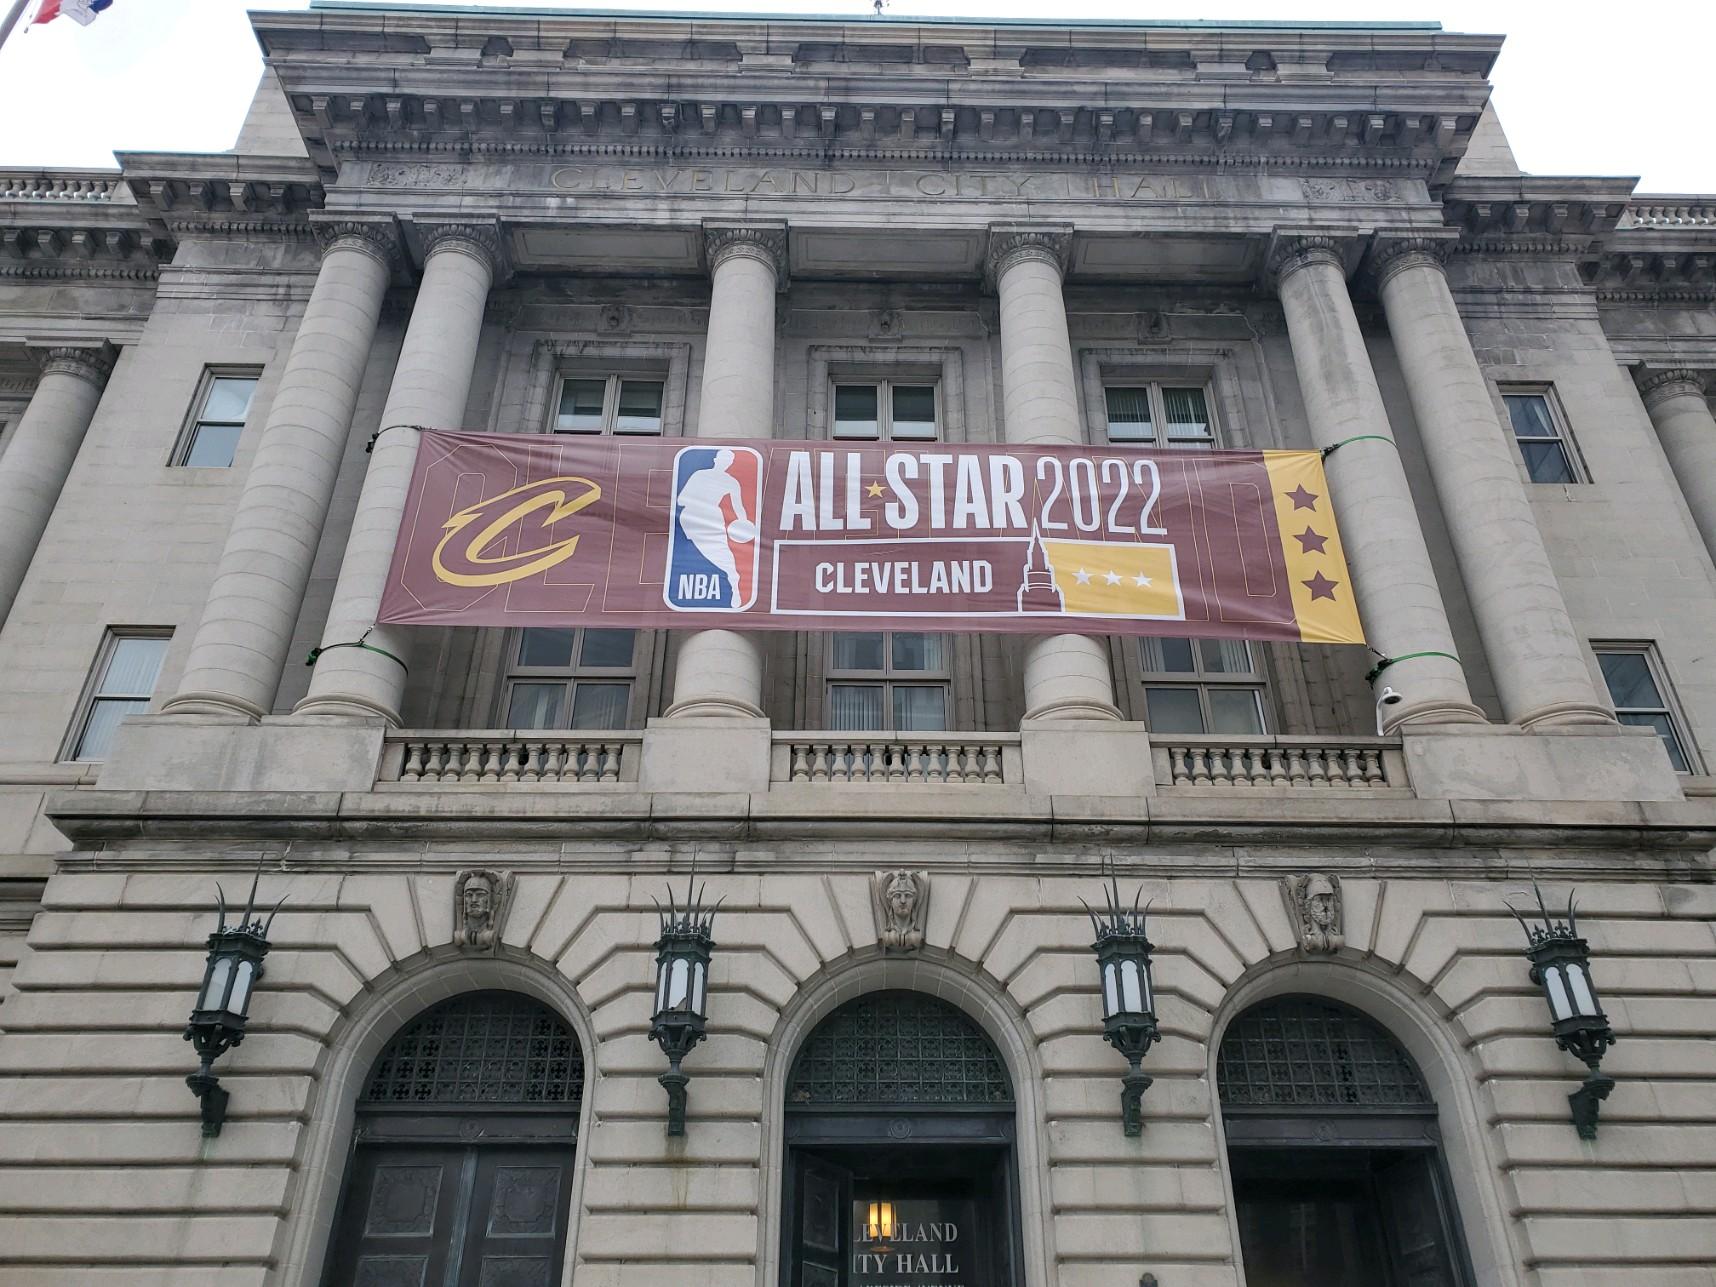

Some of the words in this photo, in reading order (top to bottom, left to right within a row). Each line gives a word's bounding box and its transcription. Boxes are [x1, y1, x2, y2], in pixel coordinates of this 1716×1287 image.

[551, 167, 856, 195] CLEVELAND
[915, 174, 1033, 197] CITY
[779, 451, 872, 531] ALL
[885, 453, 1029, 530] STAR
[1036, 456, 1168, 536] 2022
[677, 573, 722, 601] NBA
[814, 559, 993, 595] CLEVELAND
[896, 1253, 959, 1274] HALL
